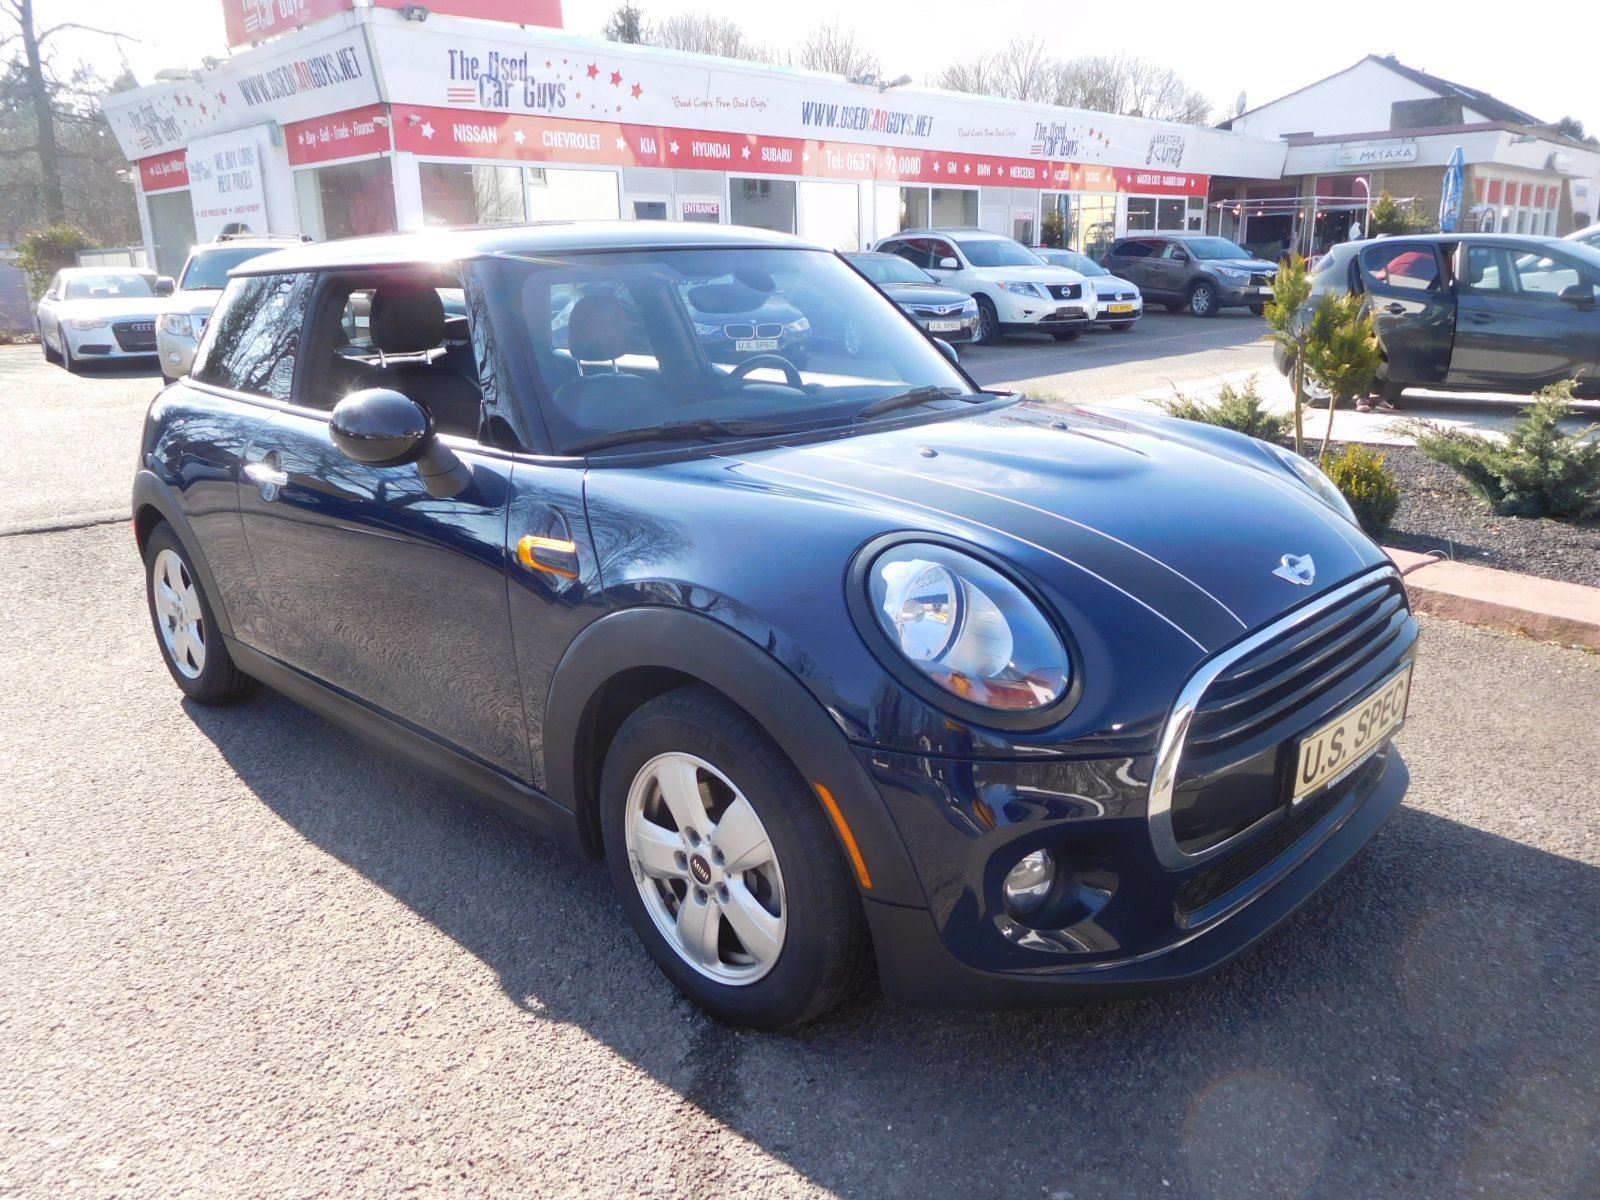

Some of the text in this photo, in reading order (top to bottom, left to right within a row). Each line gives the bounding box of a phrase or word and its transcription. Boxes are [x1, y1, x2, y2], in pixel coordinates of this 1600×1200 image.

[237, 47, 363, 106] WWW.USEDCARGUYS.NET
[447, 49, 528, 82] The Used
[479, 73, 567, 113] Car Guys
[694, 97, 713, 108] Cars
[715, 97, 731, 108] From
[733, 97, 749, 109] Good
[802, 101, 934, 138] WWW.USEDCARGUYS.NET
[305, 121, 375, 148] Buy Sell Trade Finance
[1033, 122, 1067, 142] The Used
[1156, 133, 1181, 147] MASTER
[453, 124, 793, 163] NISSAN CHEVROLET KIA HYUNDAI SUBARU
[1042, 137, 1079, 158] Car Guys
[1360, 147, 1412, 162] METAXA
[826, 150, 921, 175] Tel: 06371 92 0000
[948, 162, 957, 174] GM
[977, 164, 991, 176] BMW
[1010, 166, 1036, 179] MERCEDES
[684, 203, 719, 214] ENTRANCE
[754, 341, 776, 349] SPEC
[1303, 725, 1347, 785] U.S.
[1354, 679, 1404, 749] SPEC
[692, 858, 709, 880] MINI
